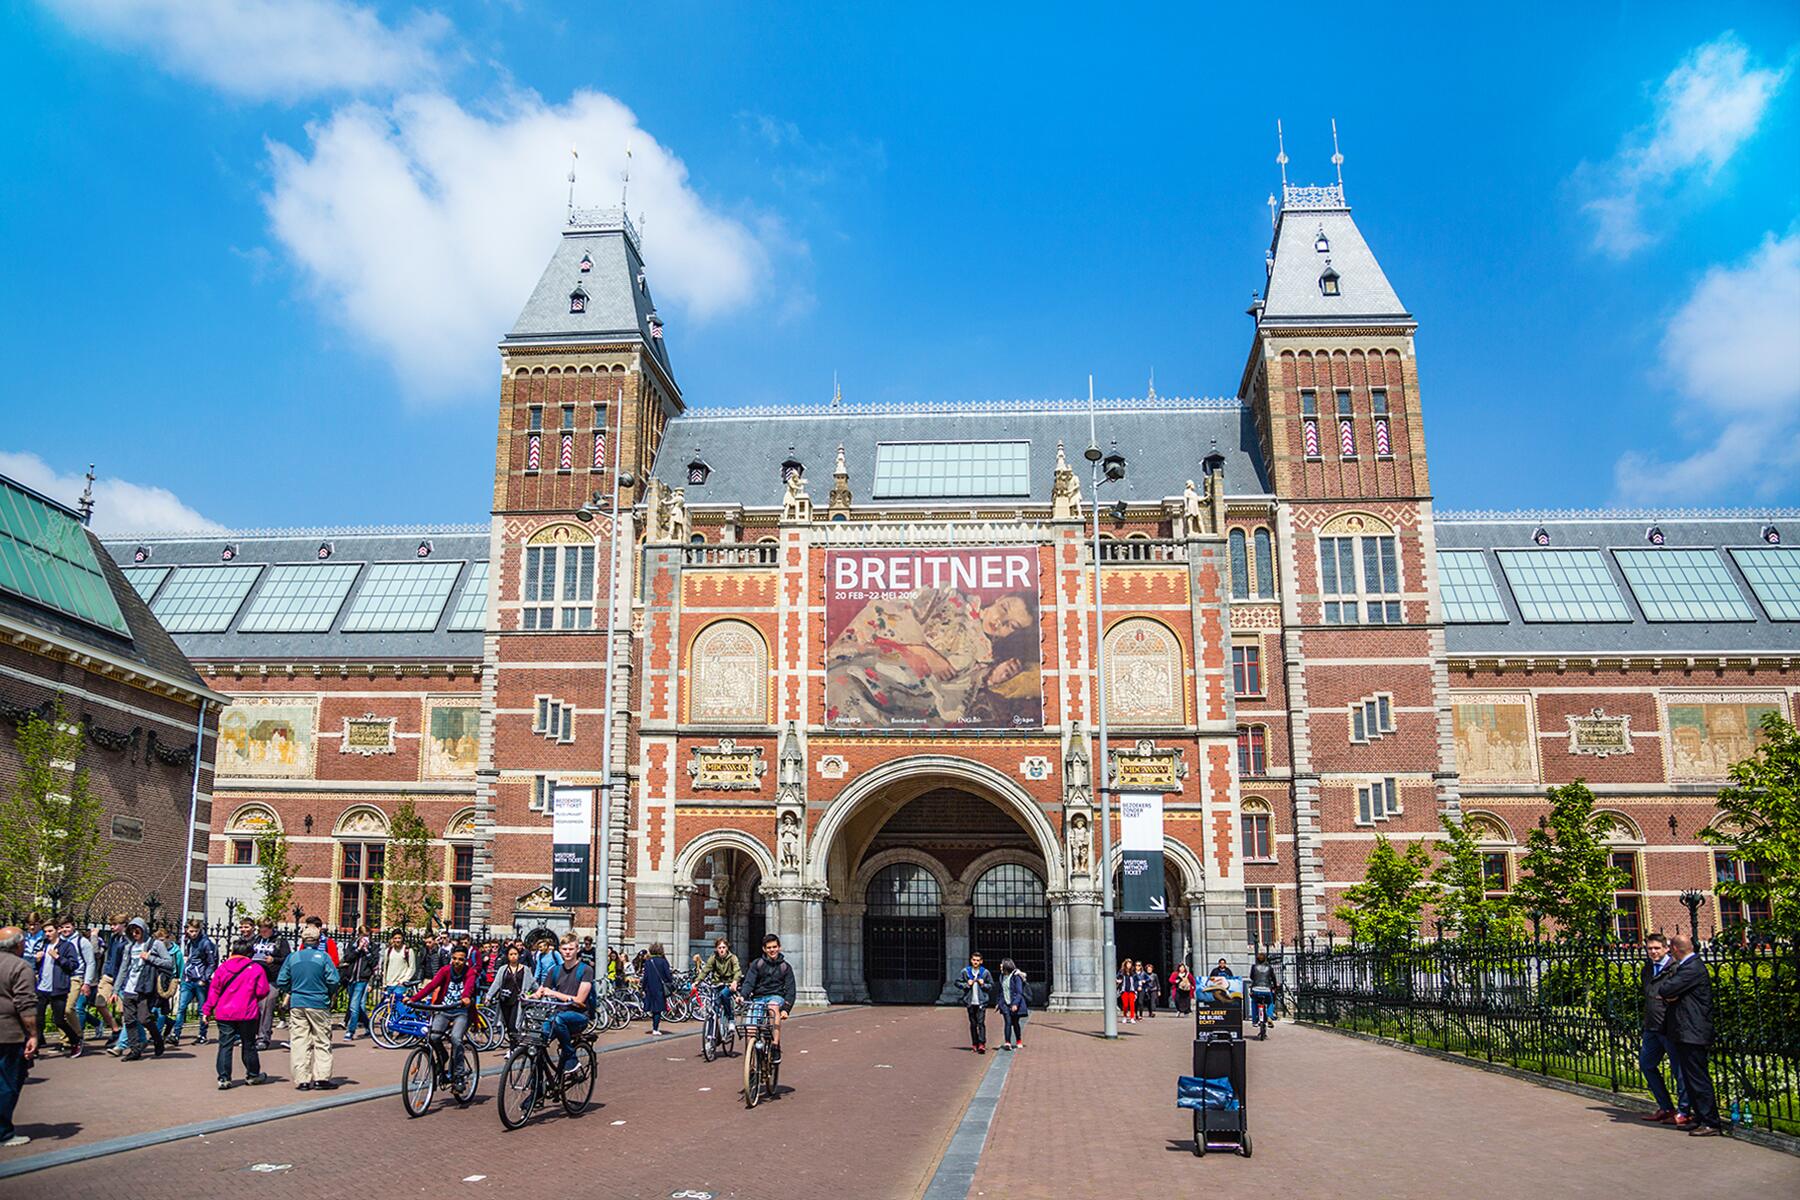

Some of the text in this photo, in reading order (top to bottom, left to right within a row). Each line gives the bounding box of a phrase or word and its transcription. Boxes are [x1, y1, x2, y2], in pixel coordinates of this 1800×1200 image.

[835, 556, 1031, 589] BREITNER
[835, 591, 847, 600] 20
[881, 591, 897, 600] MEI
[898, 591, 918, 600] 2016
